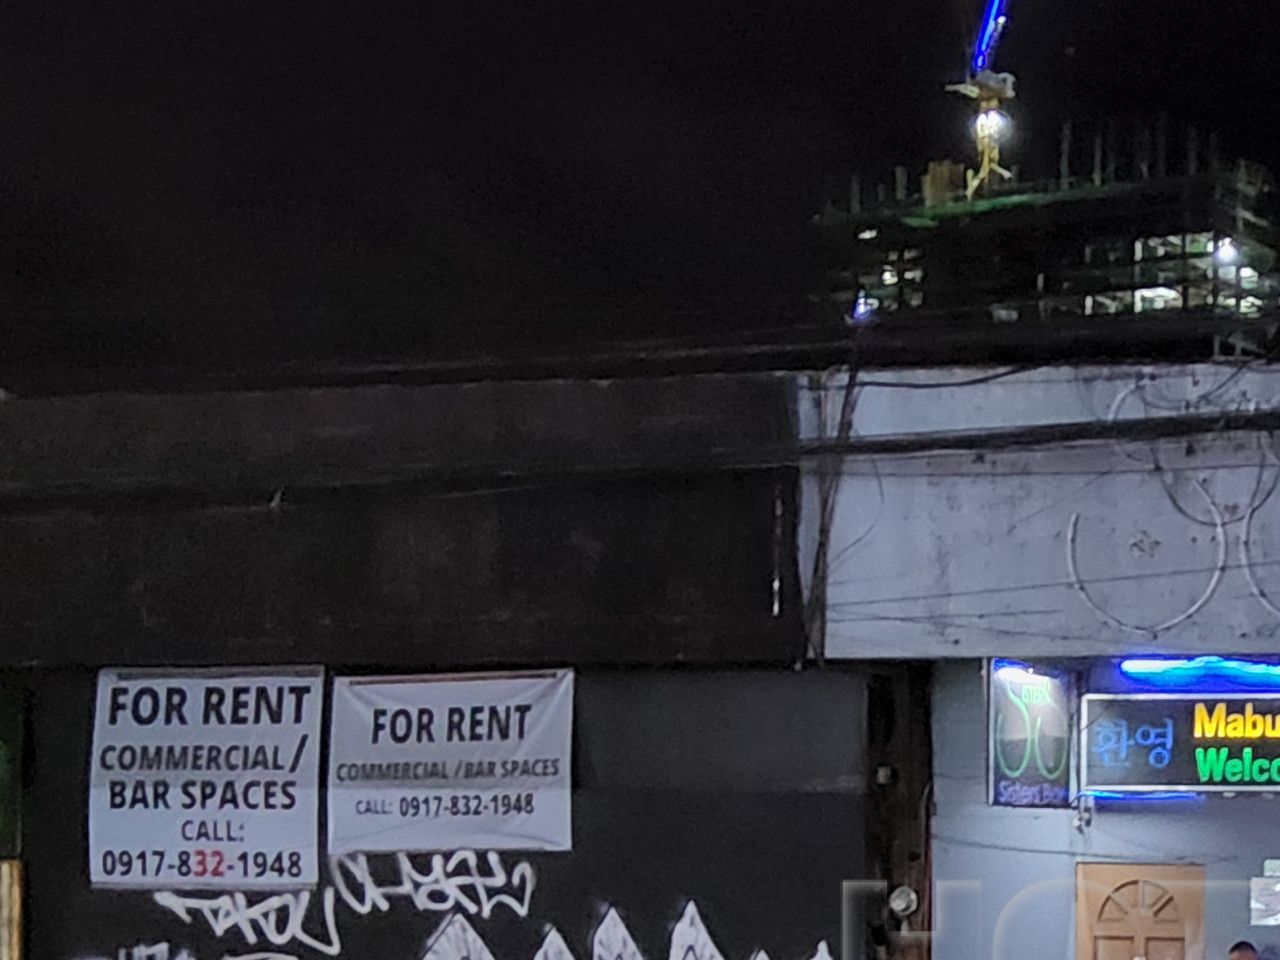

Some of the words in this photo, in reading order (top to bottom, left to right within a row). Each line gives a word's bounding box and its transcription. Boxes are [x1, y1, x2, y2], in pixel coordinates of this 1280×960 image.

[108, 686, 188, 726] FOR
[202, 685, 312, 726] RENT
[371, 708, 435, 744] FOR
[446, 704, 532, 742] RENT
[336, 761, 449, 782] COMMERCIAL
[501, 758, 560, 778] SPACES
[108, 780, 171, 810] BAR
[180, 780, 298, 810] SPACES
[399, 793, 535, 817] 0917-832-1948
[181, 819, 245, 843] CALL:
[102, 850, 303, 877] 0917-832-1948
